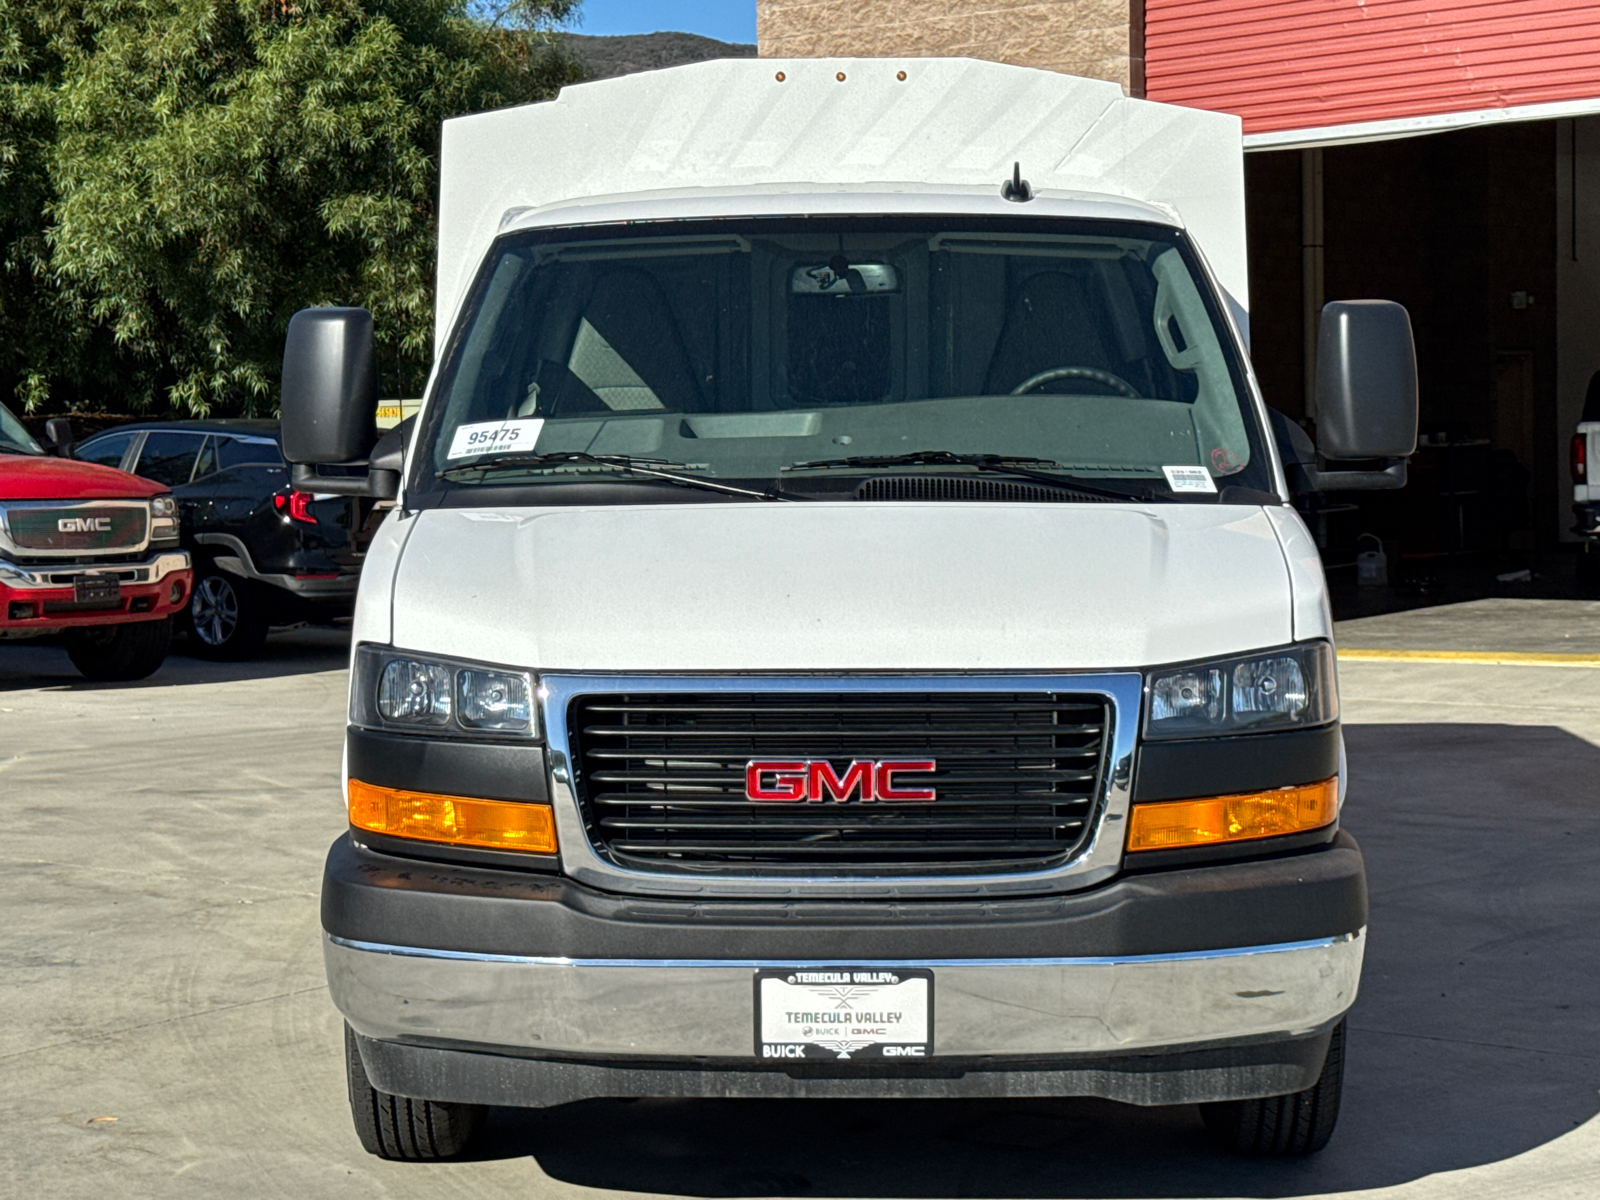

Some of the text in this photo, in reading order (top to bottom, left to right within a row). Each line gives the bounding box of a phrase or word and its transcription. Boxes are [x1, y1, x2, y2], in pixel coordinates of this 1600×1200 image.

[467, 428, 521, 445] 95475
[58, 517, 112, 532] GMC
[745, 759, 936, 802] GMC
[795, 972, 892, 983] TEMECULA VALLEY
[786, 1012, 902, 1024] TEMECULA VALLEY
[762, 1045, 805, 1058] BUICK
[882, 1046, 925, 1056] GMC
